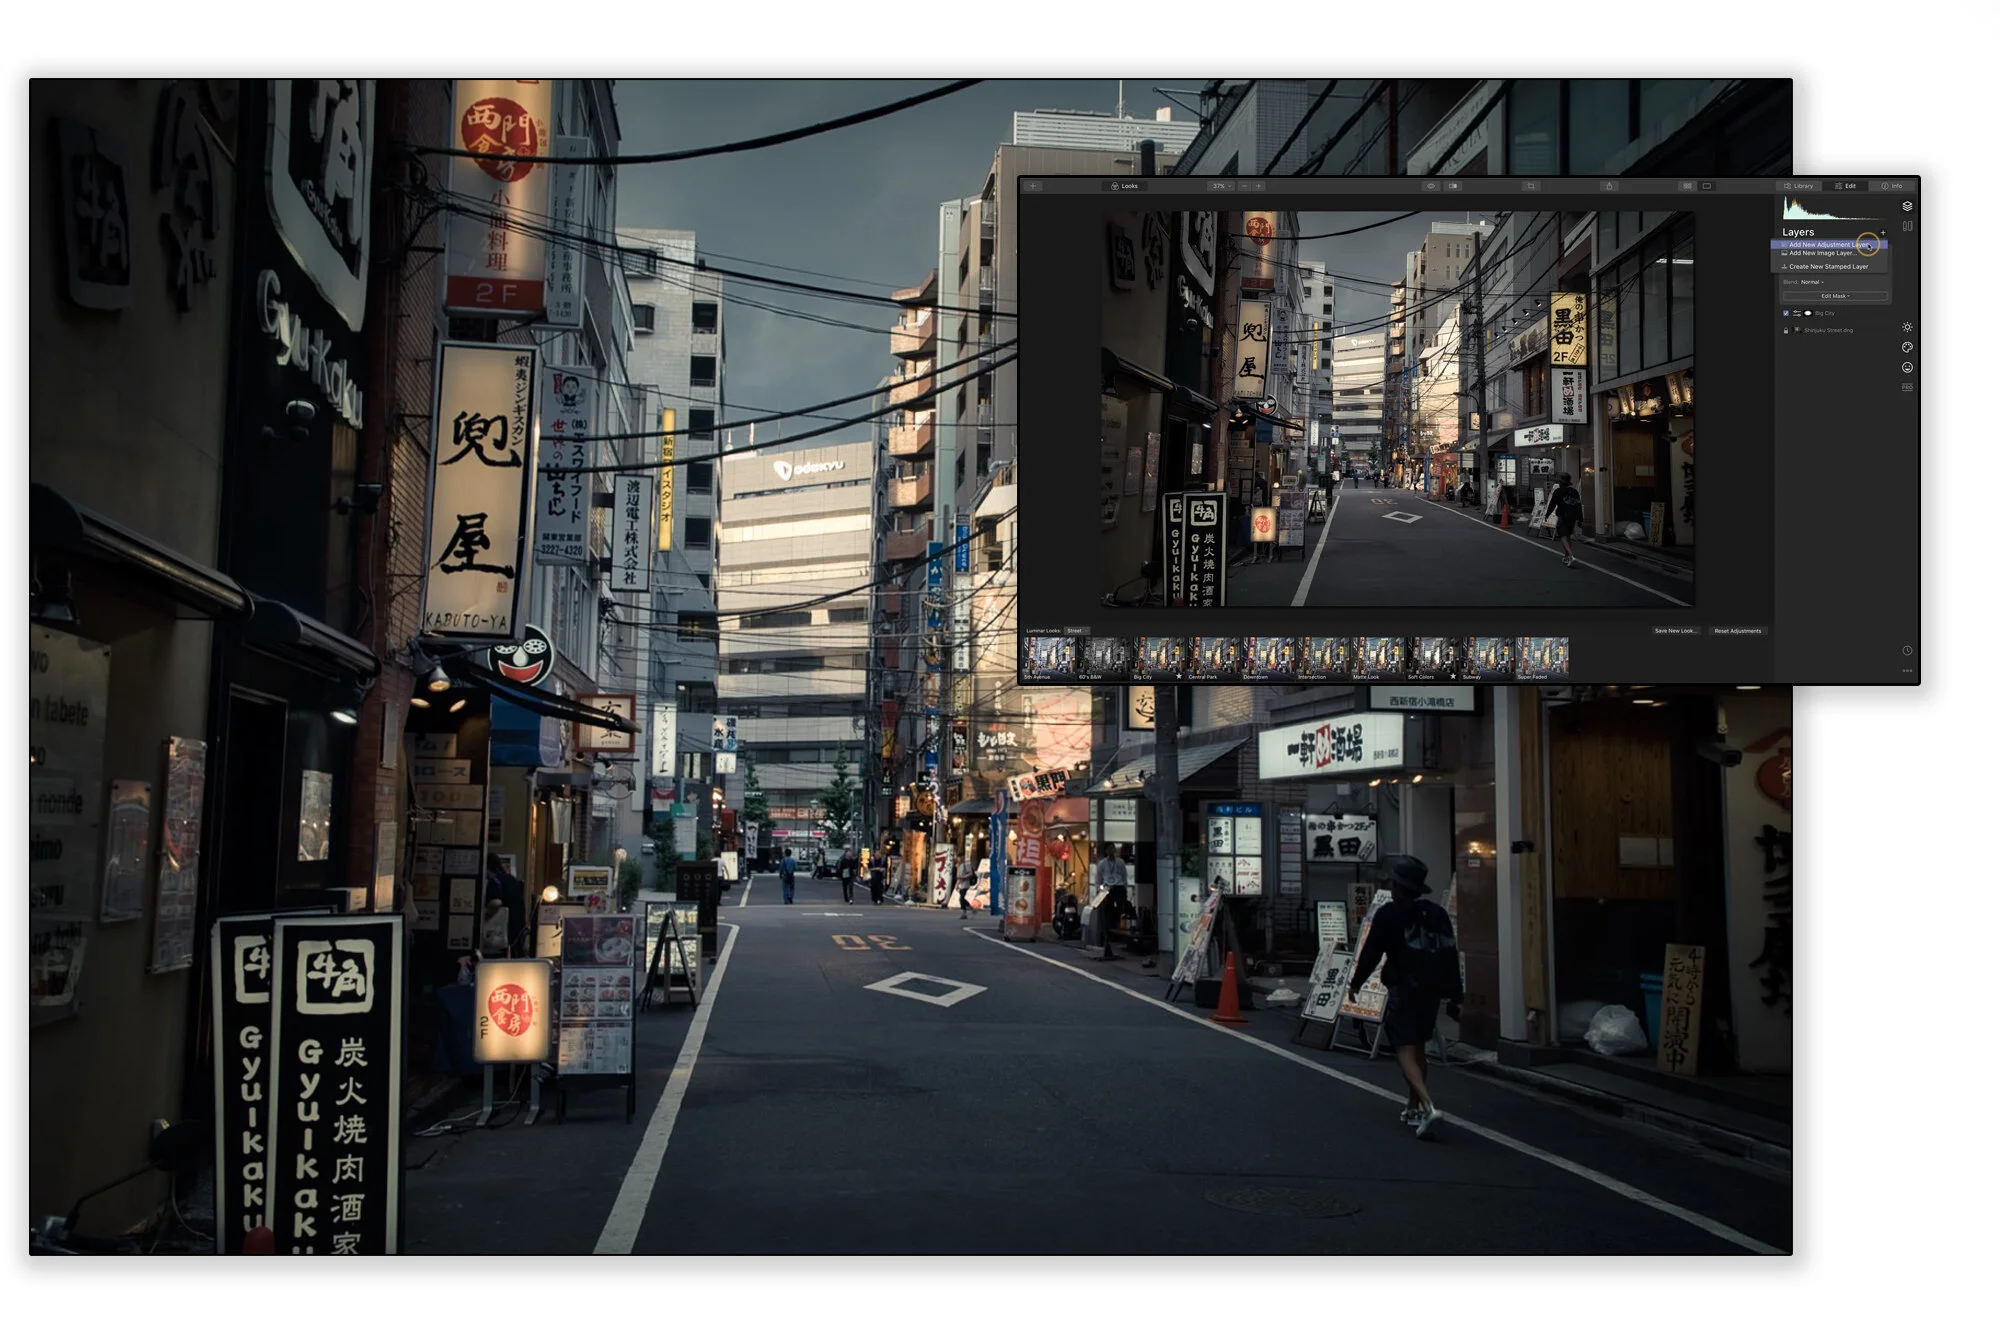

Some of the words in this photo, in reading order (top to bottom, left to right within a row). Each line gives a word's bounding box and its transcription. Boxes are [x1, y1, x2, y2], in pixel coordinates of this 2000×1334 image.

[1793, 183, 1814, 191] Library
[1782, 228, 1815, 239] Layers
[1817, 241, 1851, 249] Adjustment
[1817, 250, 1835, 258] Image
[475, 282, 518, 304] 2F
[1553, 308, 1575, 345] 黒田
[1553, 351, 1568, 362] 2F
[430, 410, 522, 579] 兜屋
[1194, 503, 1214, 521] 牛角
[623, 480, 641, 585] 渡辺電工株式会社
[541, 543, 583, 556] 3227-4320
[426, 612, 508, 631] KABUTO-YA
[1313, 834, 1362, 858] 黒田
[306, 953, 367, 998] 牛角
[491, 988, 529, 1013] 西門
